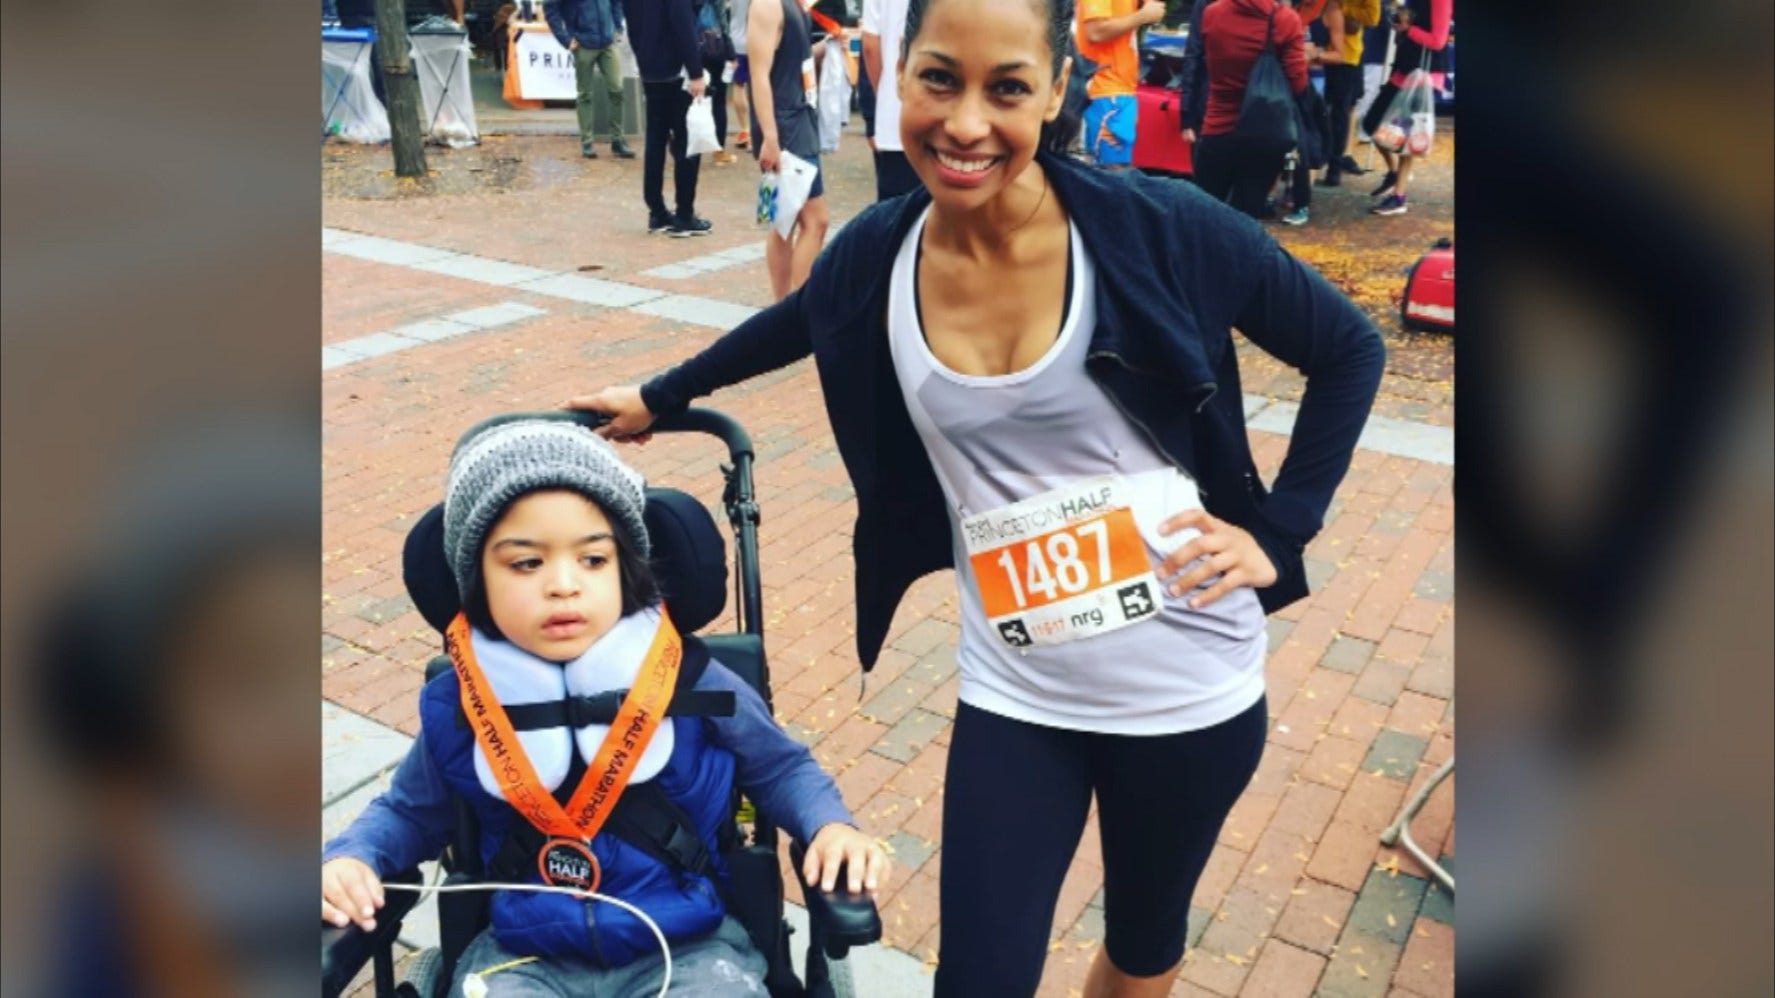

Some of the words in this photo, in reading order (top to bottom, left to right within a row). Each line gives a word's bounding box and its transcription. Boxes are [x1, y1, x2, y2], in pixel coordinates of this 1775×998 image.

[998, 519, 1112, 608] 1487
[1071, 607, 1104, 627] nrg
[447, 631, 487, 715] MARATHON
[478, 715, 508, 758] HALF
[624, 708, 649, 750] HALF
[576, 749, 629, 830] MARATHON
[548, 860, 590, 880] HALF
